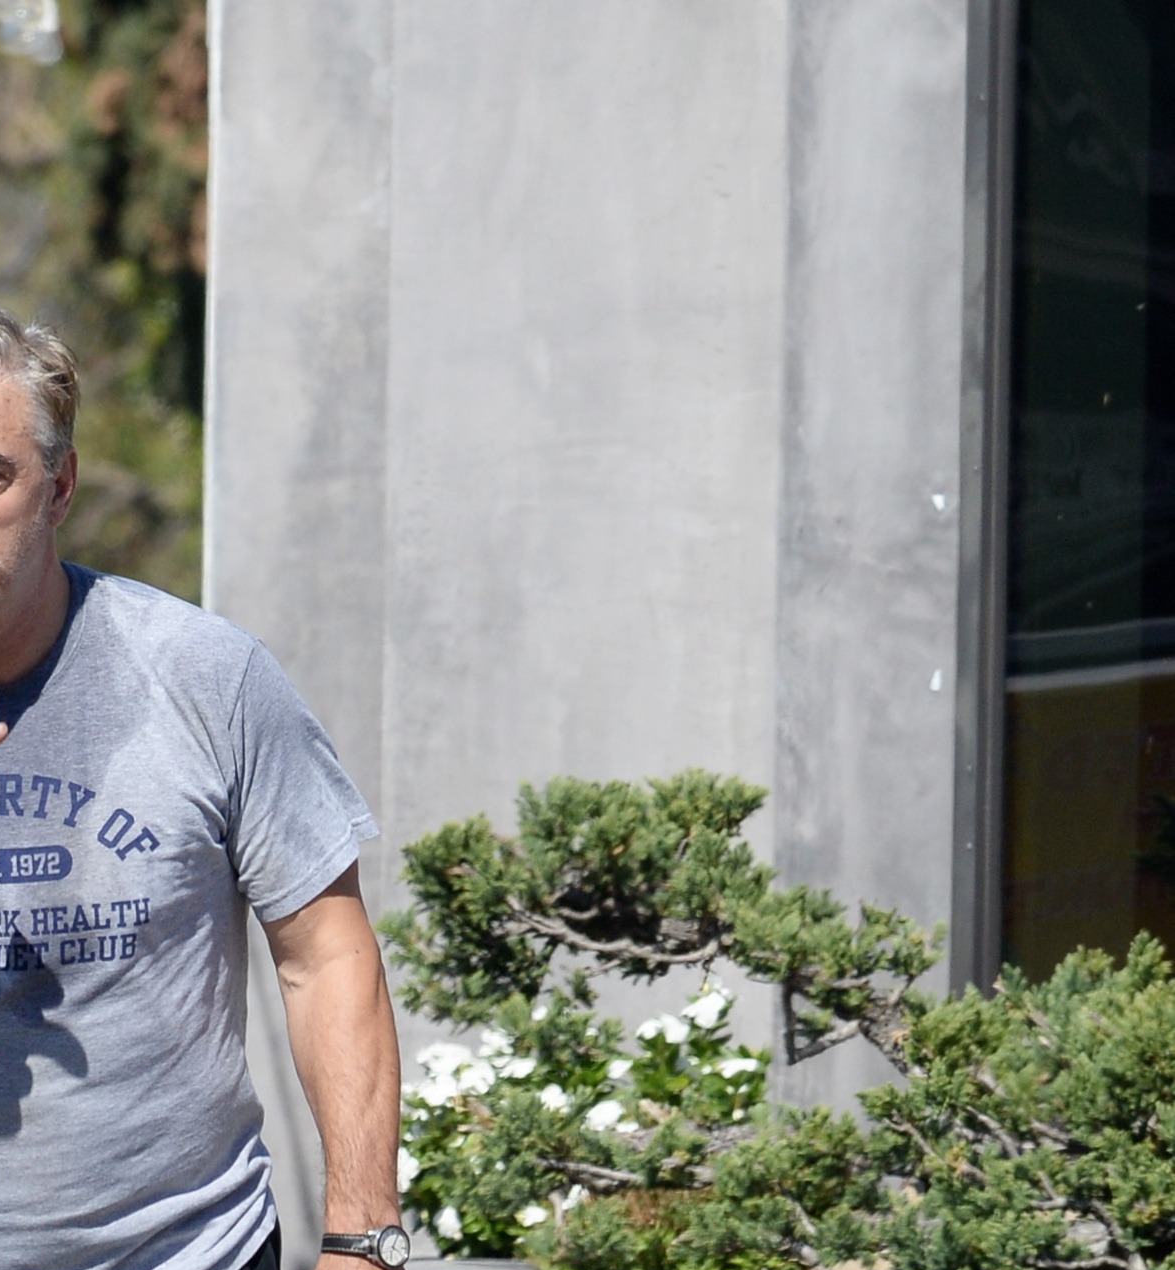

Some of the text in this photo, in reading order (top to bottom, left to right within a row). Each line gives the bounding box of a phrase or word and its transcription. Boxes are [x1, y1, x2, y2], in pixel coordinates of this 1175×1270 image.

[97, 808, 160, 861] OF
[10, 853, 61, 878] 1972
[30, 898, 151, 936] HEALTH
[59, 933, 138, 966] CLUB
